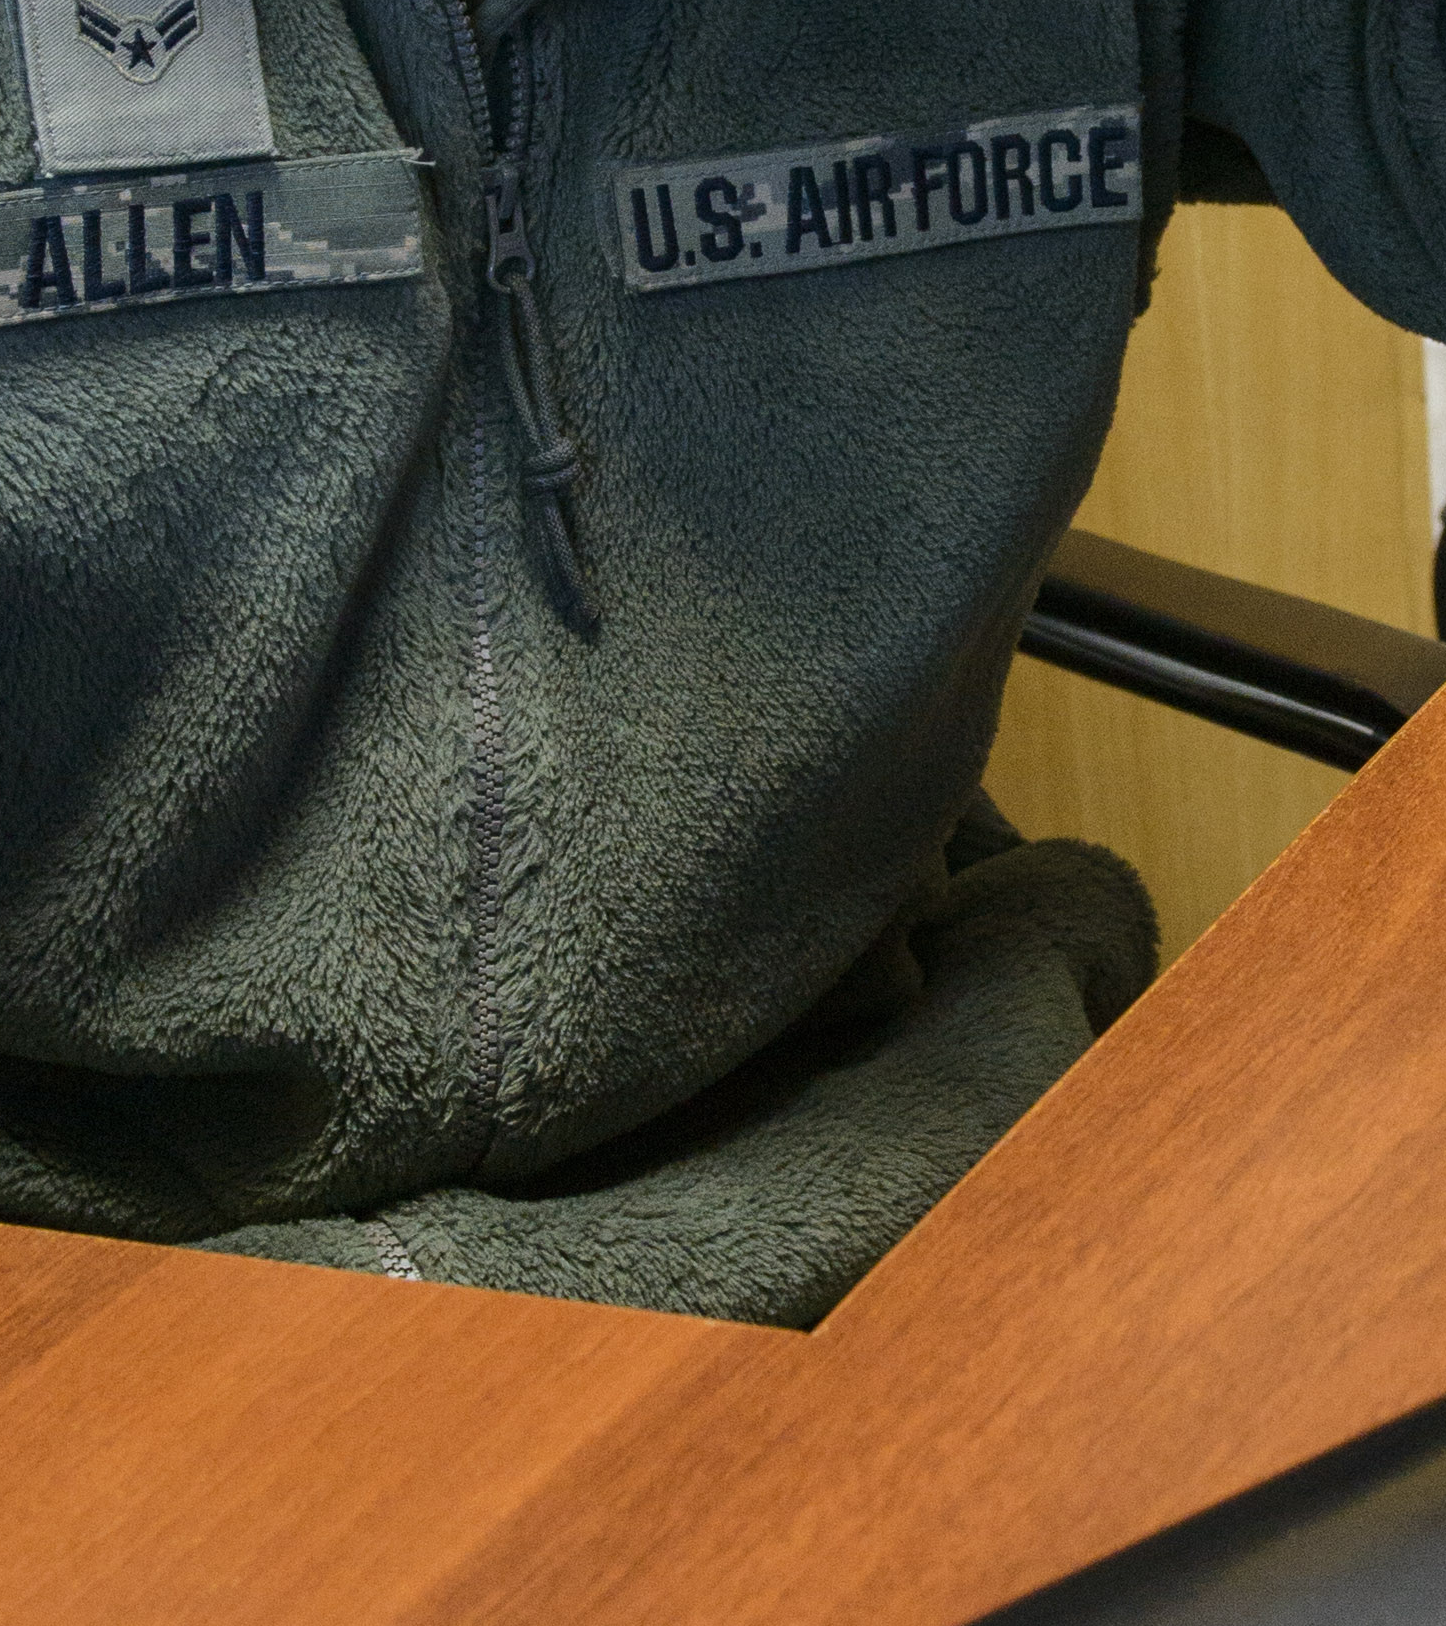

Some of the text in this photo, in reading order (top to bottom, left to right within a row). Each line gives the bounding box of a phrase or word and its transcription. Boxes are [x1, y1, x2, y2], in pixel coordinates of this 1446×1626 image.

[18, 190, 266, 308] ALLEN
[630, 120, 1130, 274] U.S. AIR FORCE
